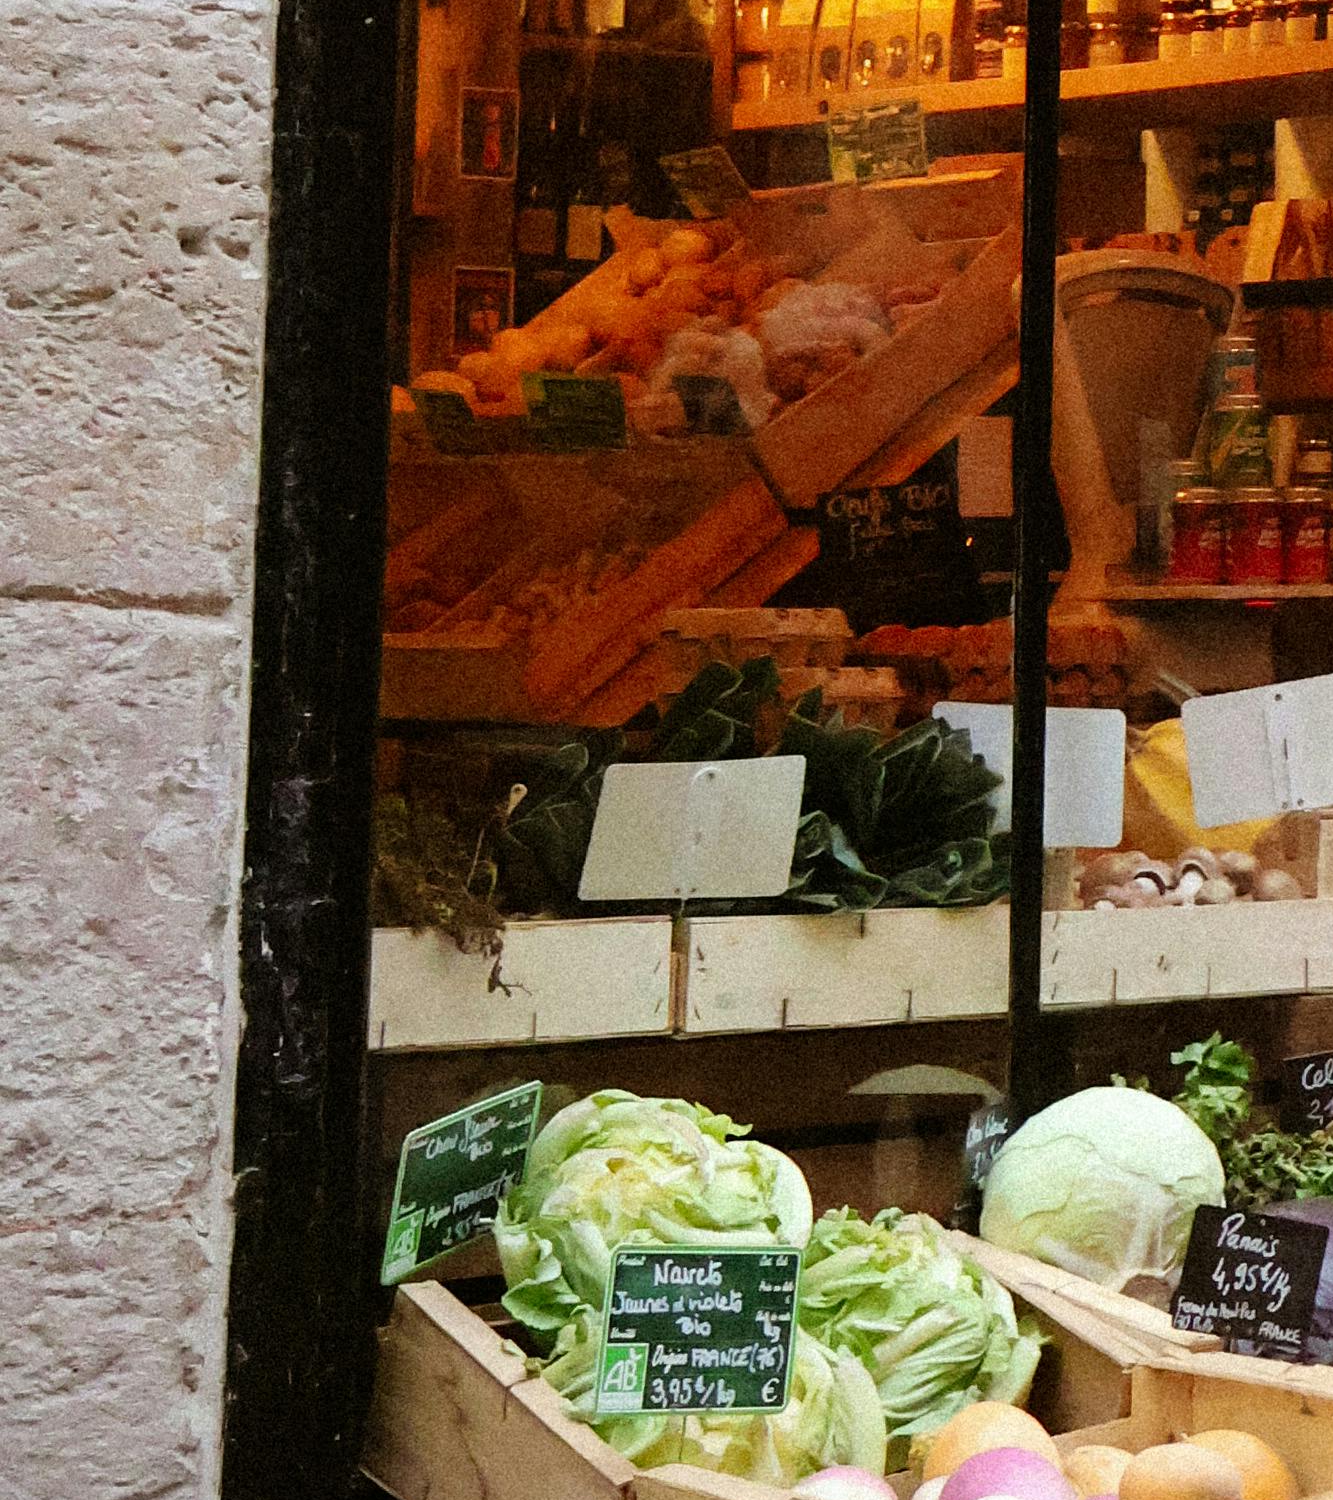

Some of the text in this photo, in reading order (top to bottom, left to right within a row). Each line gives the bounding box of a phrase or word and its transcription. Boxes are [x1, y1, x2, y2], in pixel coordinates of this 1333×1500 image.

[1216, 1212, 1281, 1259] Panais
[653, 1258, 723, 1287] Navets
[611, 1290, 670, 1316] Jaunes
[674, 1313, 712, 1337] Bio
[1257, 1320, 1302, 1345] FRANCE
[602, 1359, 638, 1392] AB
[761, 1377, 780, 1404] €
